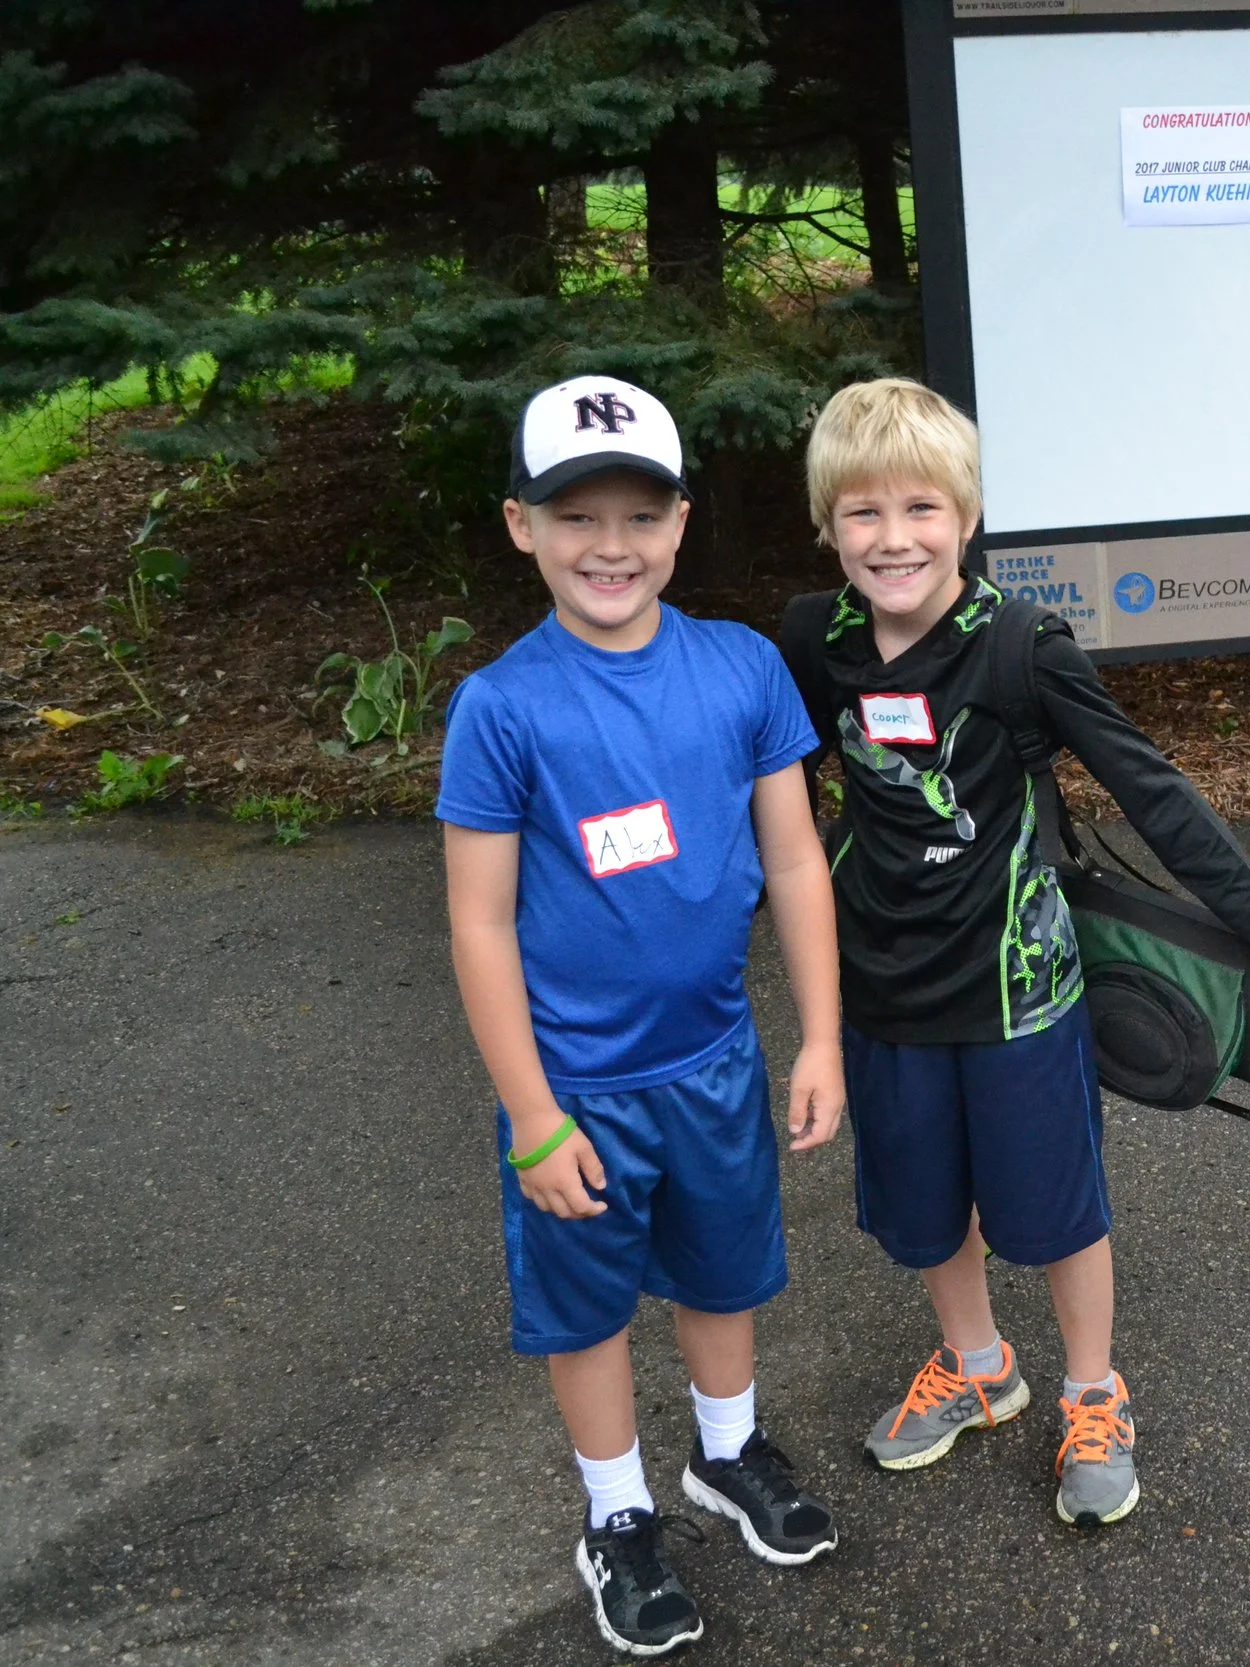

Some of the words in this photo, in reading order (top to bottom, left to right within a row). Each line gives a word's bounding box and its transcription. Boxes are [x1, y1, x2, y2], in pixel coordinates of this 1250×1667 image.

[1135, 162, 1159, 174] 2017
[1161, 161, 1200, 174] JUNIOR
[1203, 160, 1227, 173] CLUB
[1143, 184, 1201, 204] LAYTON
[573, 392, 638, 436] NP
[995, 555, 1055, 570] STRIKE
[996, 568, 1049, 584] FORCE
[1059, 606, 1096, 620] Shop
[1159, 605, 1167, 613] A
[1168, 602, 1202, 613] DIGITAL
[599, 825, 664, 867] Alex
